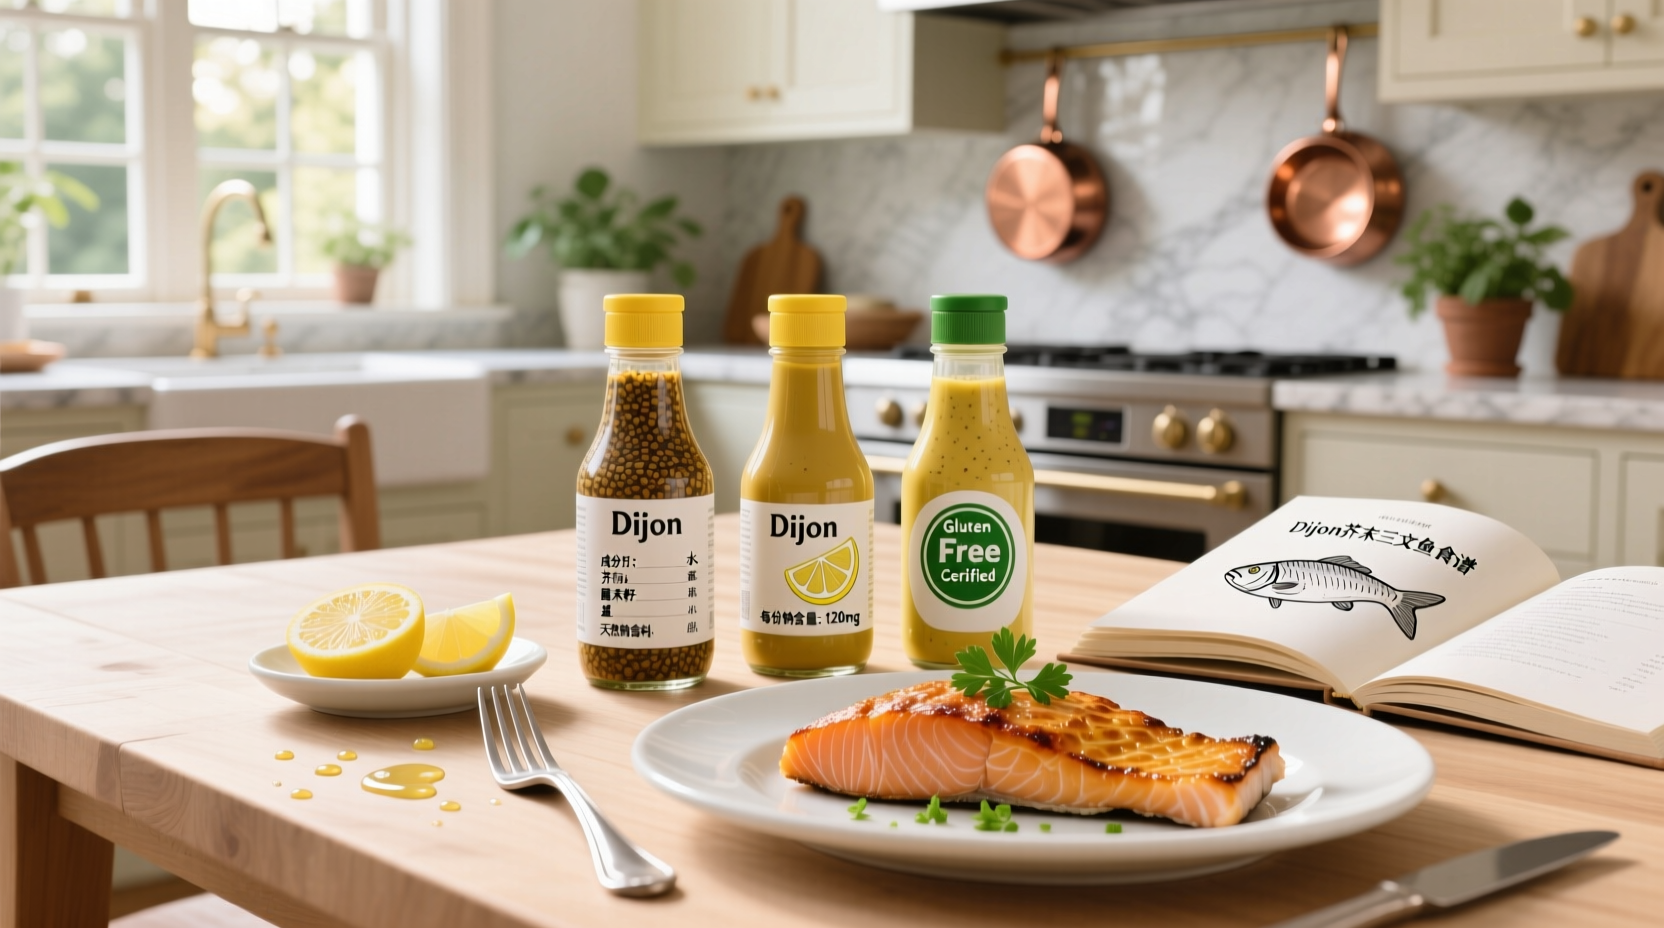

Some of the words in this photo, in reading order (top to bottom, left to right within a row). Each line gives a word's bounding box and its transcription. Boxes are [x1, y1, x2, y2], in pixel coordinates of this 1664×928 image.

[612, 510, 682, 543] Dijon
[770, 513, 838, 546] Dijon
[943, 518, 991, 534] Gluten
[938, 537, 1001, 563] Free
